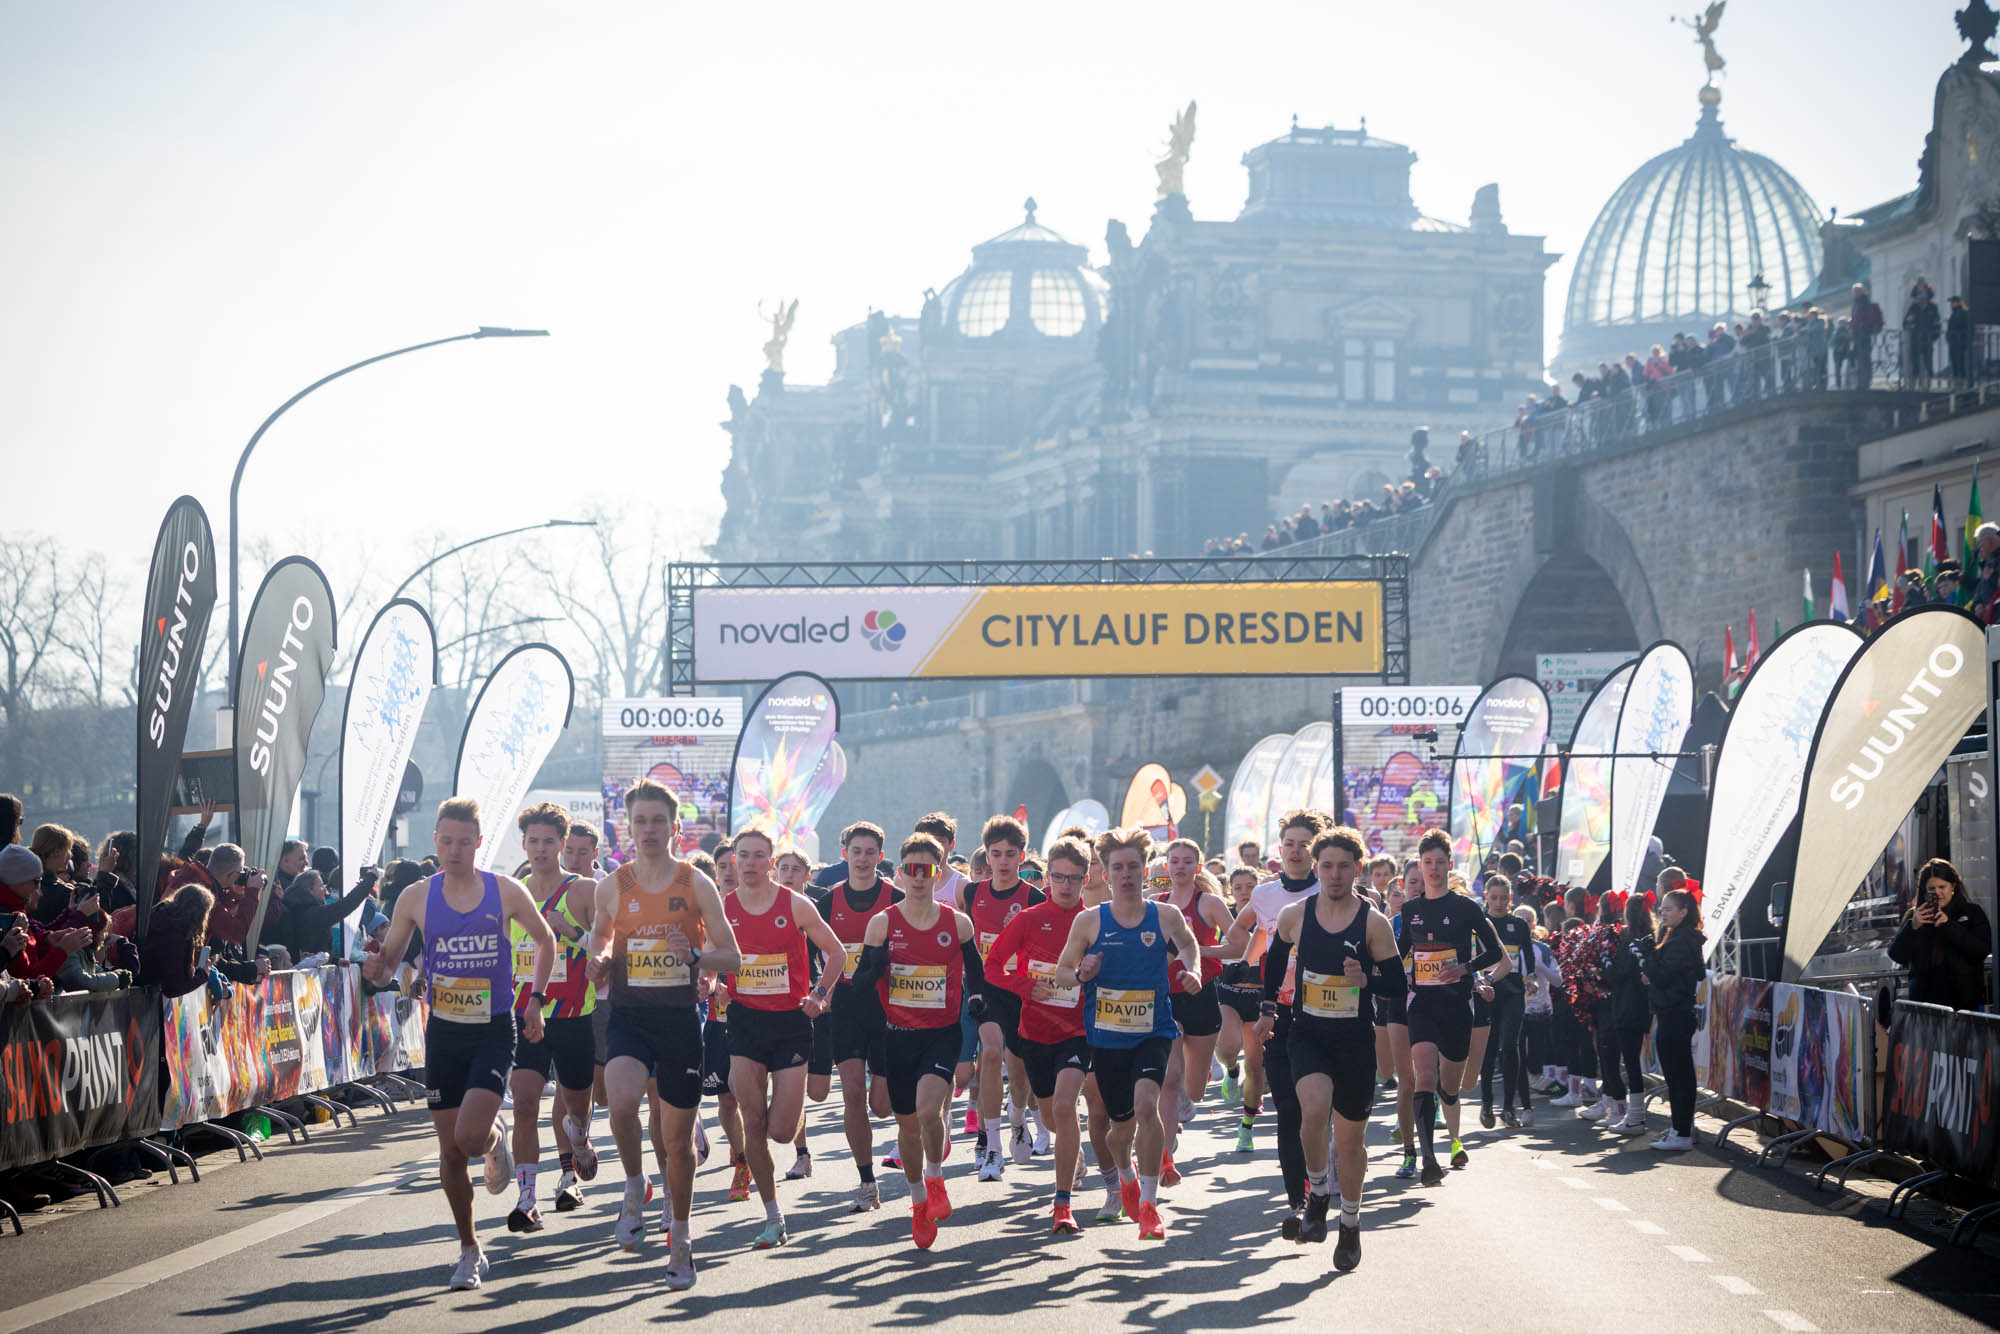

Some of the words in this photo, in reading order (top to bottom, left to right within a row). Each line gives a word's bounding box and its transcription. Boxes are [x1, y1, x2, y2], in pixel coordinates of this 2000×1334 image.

[720, 615, 850, 644] novaled
[981, 613, 1168, 647] CITYLAUF
[1184, 610, 1363, 645] DRESDEN
[150, 541, 199, 750] SUUNTO
[250, 595, 314, 777] SUUNTO
[768, 695, 811, 707] novaled
[1361, 696, 1463, 717] 00:00:06
[1486, 697, 1526, 708] novaled
[620, 707, 724, 728] 00:00:06
[1830, 643, 1964, 811] SUUNTO
[1712, 884, 1736, 920] BMW
[436, 959, 498, 969] SPORTSHOP
[740, 968, 784, 978] VALENTIN
[894, 979, 943, 991] LENNOX
[1219, 982, 1240, 992] NIKE
[440, 991, 482, 1006] JONAS
[1322, 989, 1338, 1001] TIL
[1104, 1003, 1147, 1017] DAVID
[4, 1031, 123, 1125] SAXOPRINT
